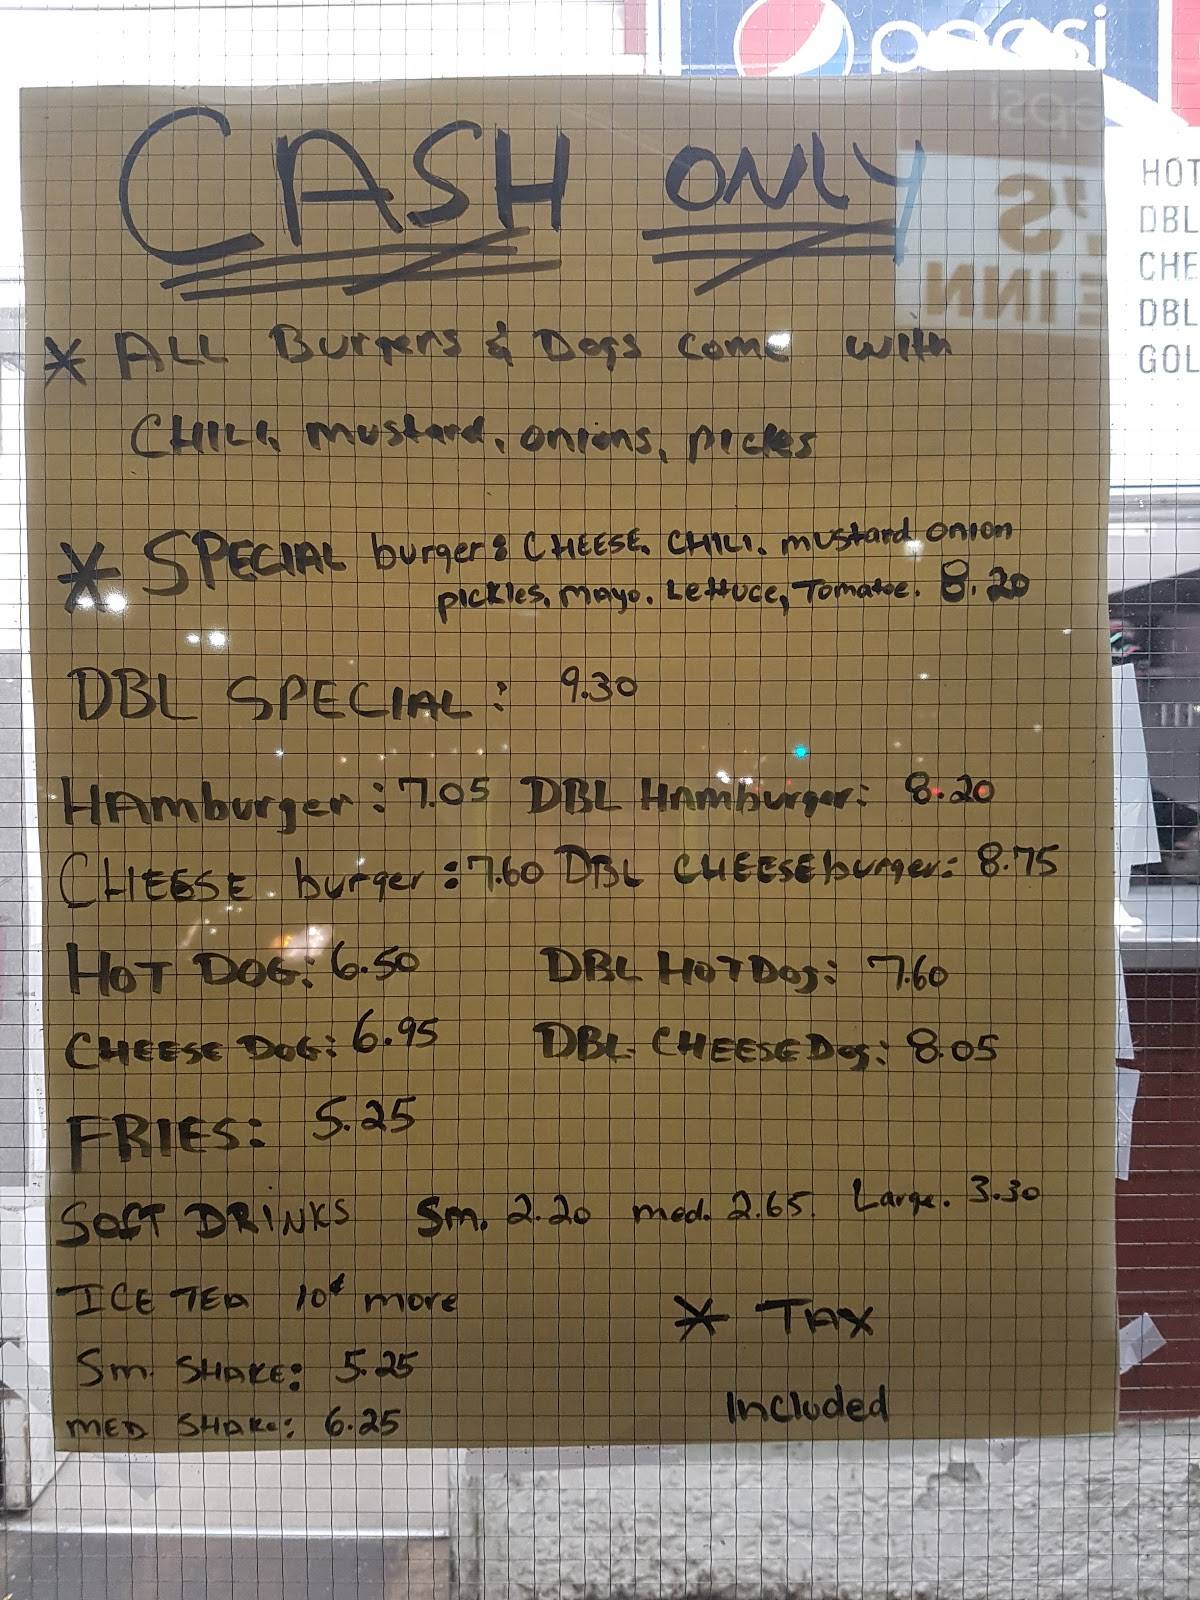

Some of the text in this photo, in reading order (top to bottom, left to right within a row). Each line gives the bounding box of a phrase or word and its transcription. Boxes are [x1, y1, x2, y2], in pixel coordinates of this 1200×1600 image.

[119, 106, 926, 265] CASH ONLY
[1140, 205, 1199, 234] DBL
[1140, 298, 1199, 327] DBL
[115, 331, 228, 380] ALL
[268, 323, 461, 367] Burgers
[532, 328, 642, 372] Dogs
[846, 327, 953, 362] with
[1139, 344, 1199, 374] GOL
[142, 529, 347, 597] SPECIAL
[781, 516, 912, 555] mustard
[925, 520, 1013, 542] onion
[940, 559, 1030, 602] 8.20
[67, 667, 198, 722] DBL
[560, 666, 638, 702] 9.30
[399, 778, 491, 807] 7.05
[520, 775, 622, 815] DBL
[904, 771, 995, 805] 8.20
[60, 851, 254, 909] CHEESE
[466, 855, 545, 893] 7.60
[554, 843, 644, 889] DBL
[976, 841, 1061, 880] 8.75
[66, 942, 173, 997] HOT
[330, 940, 421, 982] 6.50
[540, 946, 643, 985] DBL
[866, 953, 949, 992] 7.60
[65, 1031, 223, 1071] CHEESE
[352, 1008, 439, 1054] 6.95
[905, 1027, 999, 1065] 8.05
[66, 1096, 417, 1174] FRIES: 5.25
[55, 1201, 166, 1248] SOFT
[184, 1198, 351, 1239] DRINKS
[506, 1194, 592, 1227] 2.20
[968, 1174, 1042, 1203] 3.30
[55, 1282, 156, 1317] ICE
[168, 1285, 250, 1313] TEA
[364, 1292, 459, 1313] more
[755, 1297, 874, 1338] TAX
[335, 1347, 419, 1384] 5.25
[324, 1405, 402, 1438] 6.25
[726, 1385, 890, 1424] Included
